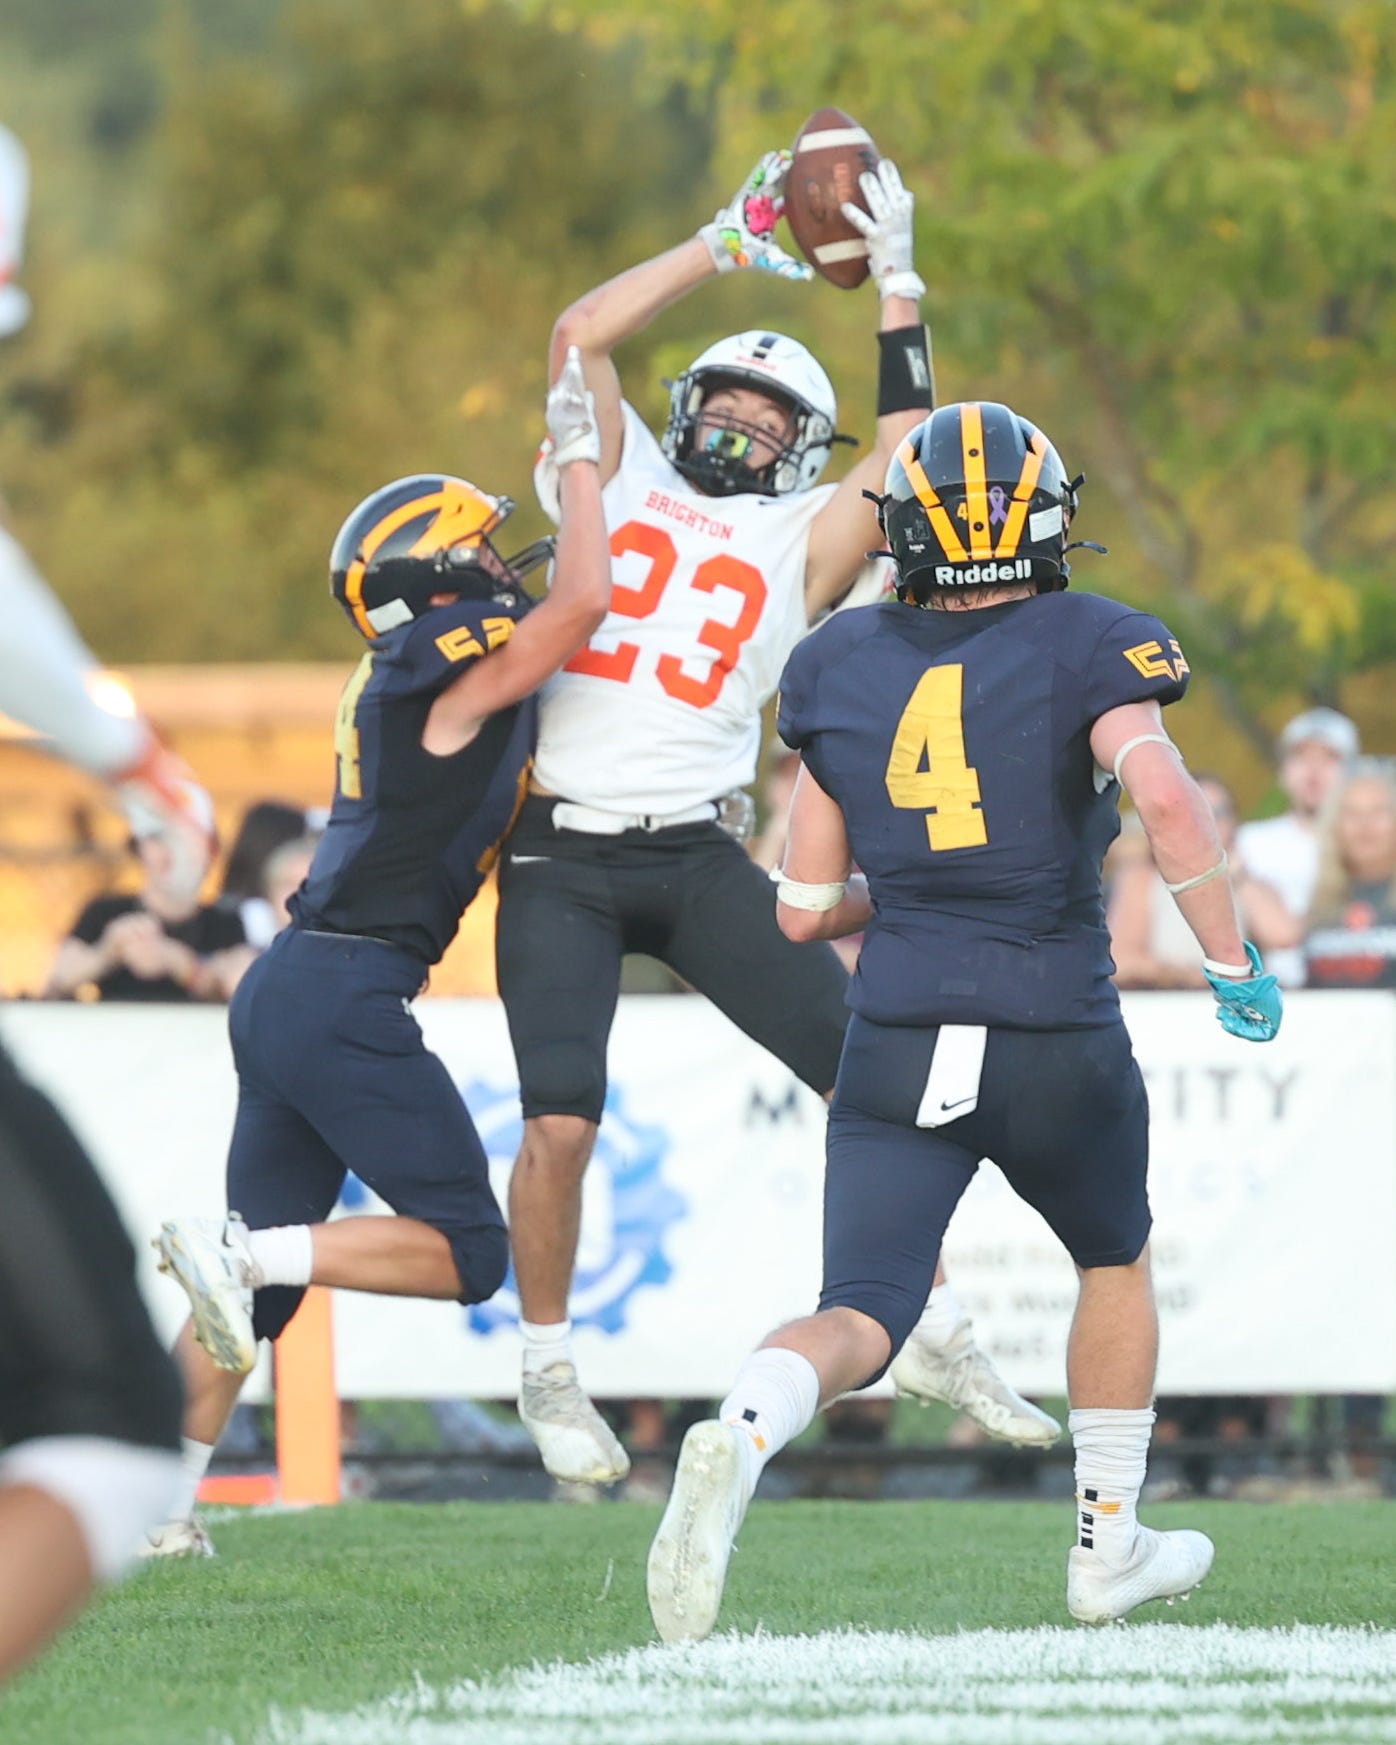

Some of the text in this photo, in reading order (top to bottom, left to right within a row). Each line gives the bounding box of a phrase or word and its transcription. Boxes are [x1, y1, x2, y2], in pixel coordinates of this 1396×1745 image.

[644, 489, 734, 540] BRIGHTON
[934, 559, 1032, 586] Riddell
[563, 519, 768, 710] 23
[884, 663, 988, 851] 4
[1144, 1063, 1302, 1120] ITY
